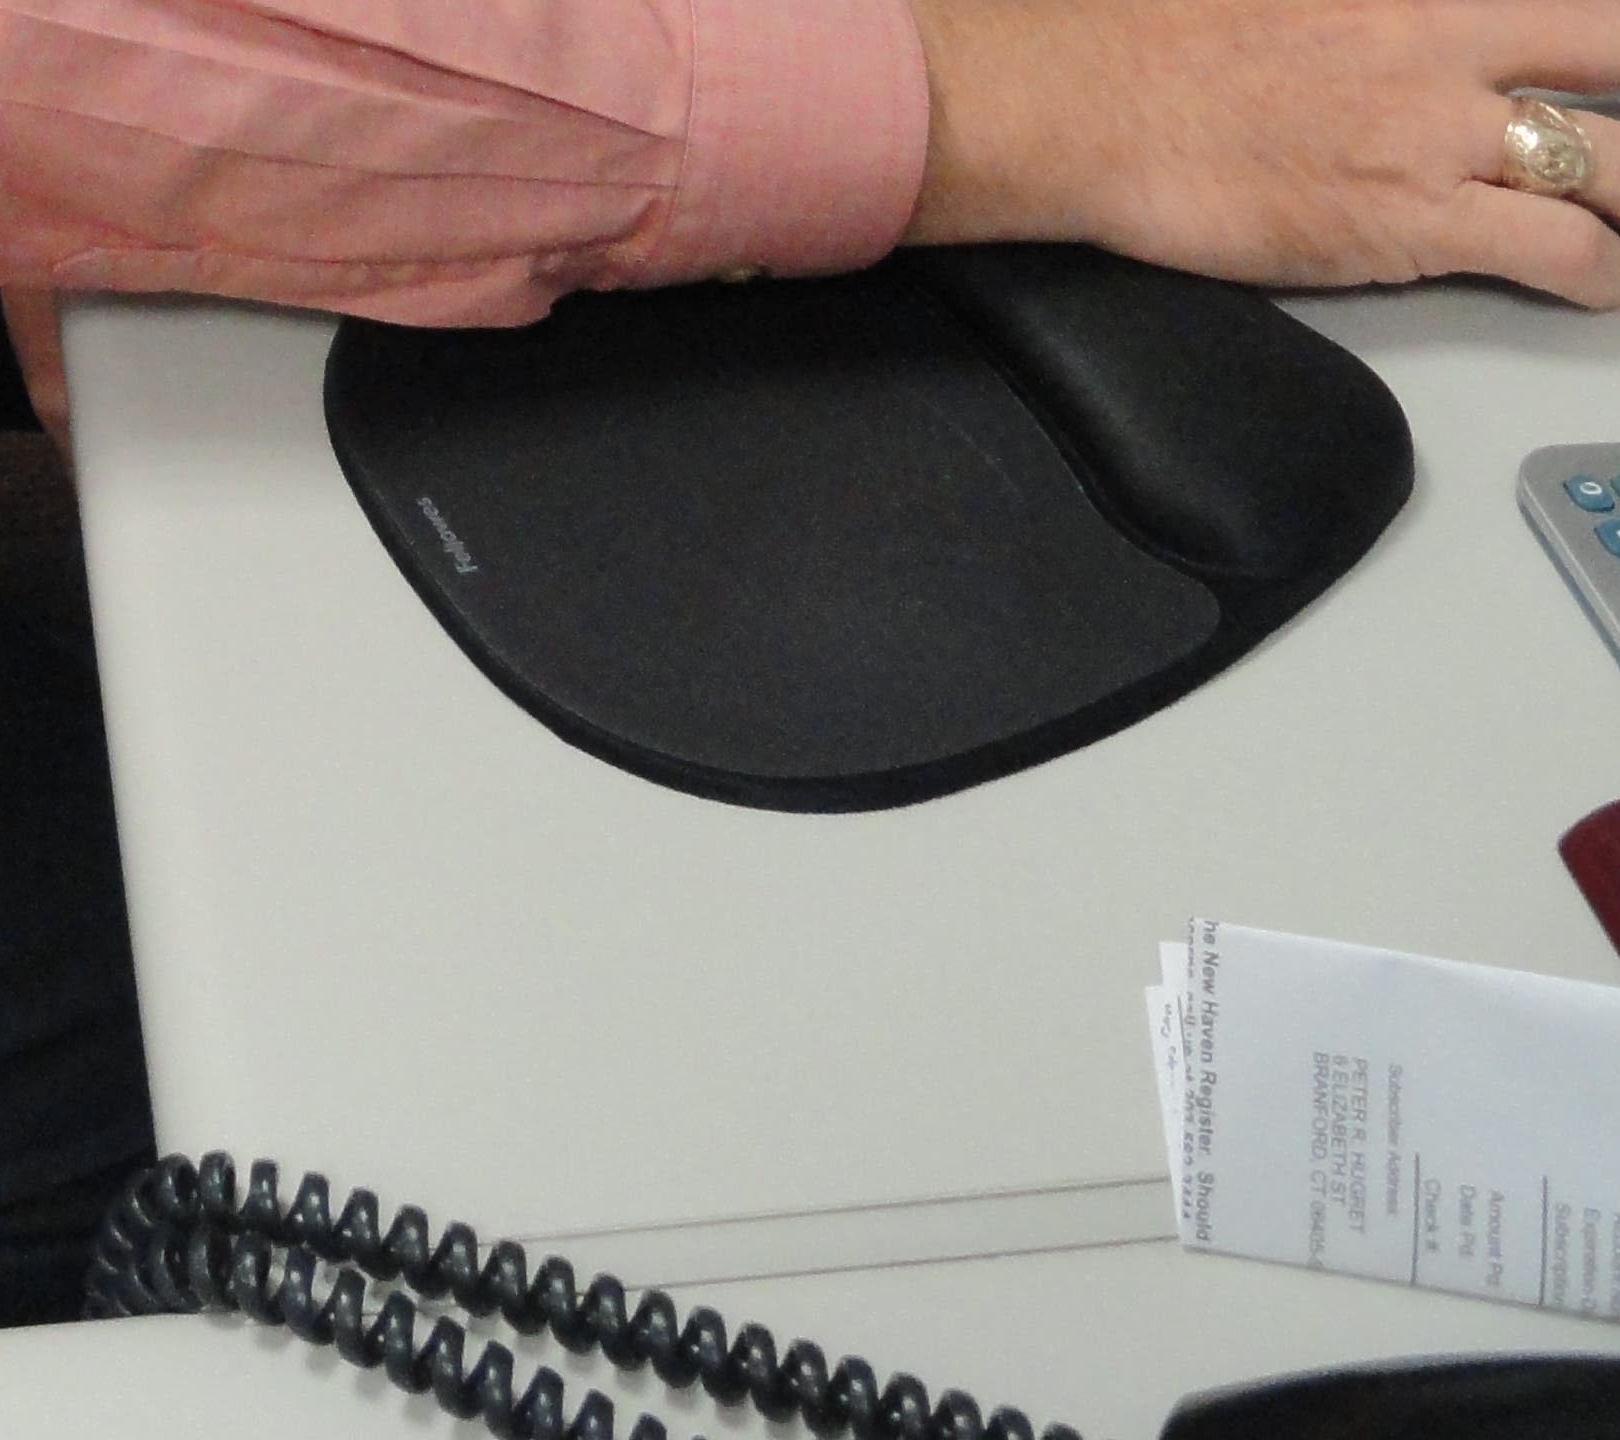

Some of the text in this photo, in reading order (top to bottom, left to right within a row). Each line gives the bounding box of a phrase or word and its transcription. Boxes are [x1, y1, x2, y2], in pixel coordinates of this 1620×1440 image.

[1201, 951, 1220, 995] New
[1200, 1000, 1220, 1063] Haven
[1309, 1051, 1331, 1163] BRANFORD,
[1351, 1056, 1368, 1123] PETER
[1387, 1063, 1404, 1146] Subscriber
[1330, 1071, 1348, 1176] ELIZABETH
[1195, 1171, 1214, 1241] Should
[1311, 1170, 1328, 1198] CT
[1331, 1181, 1347, 1206] ST
[1459, 1184, 1476, 1227] Date
[1488, 1190, 1505, 1258] Amount
